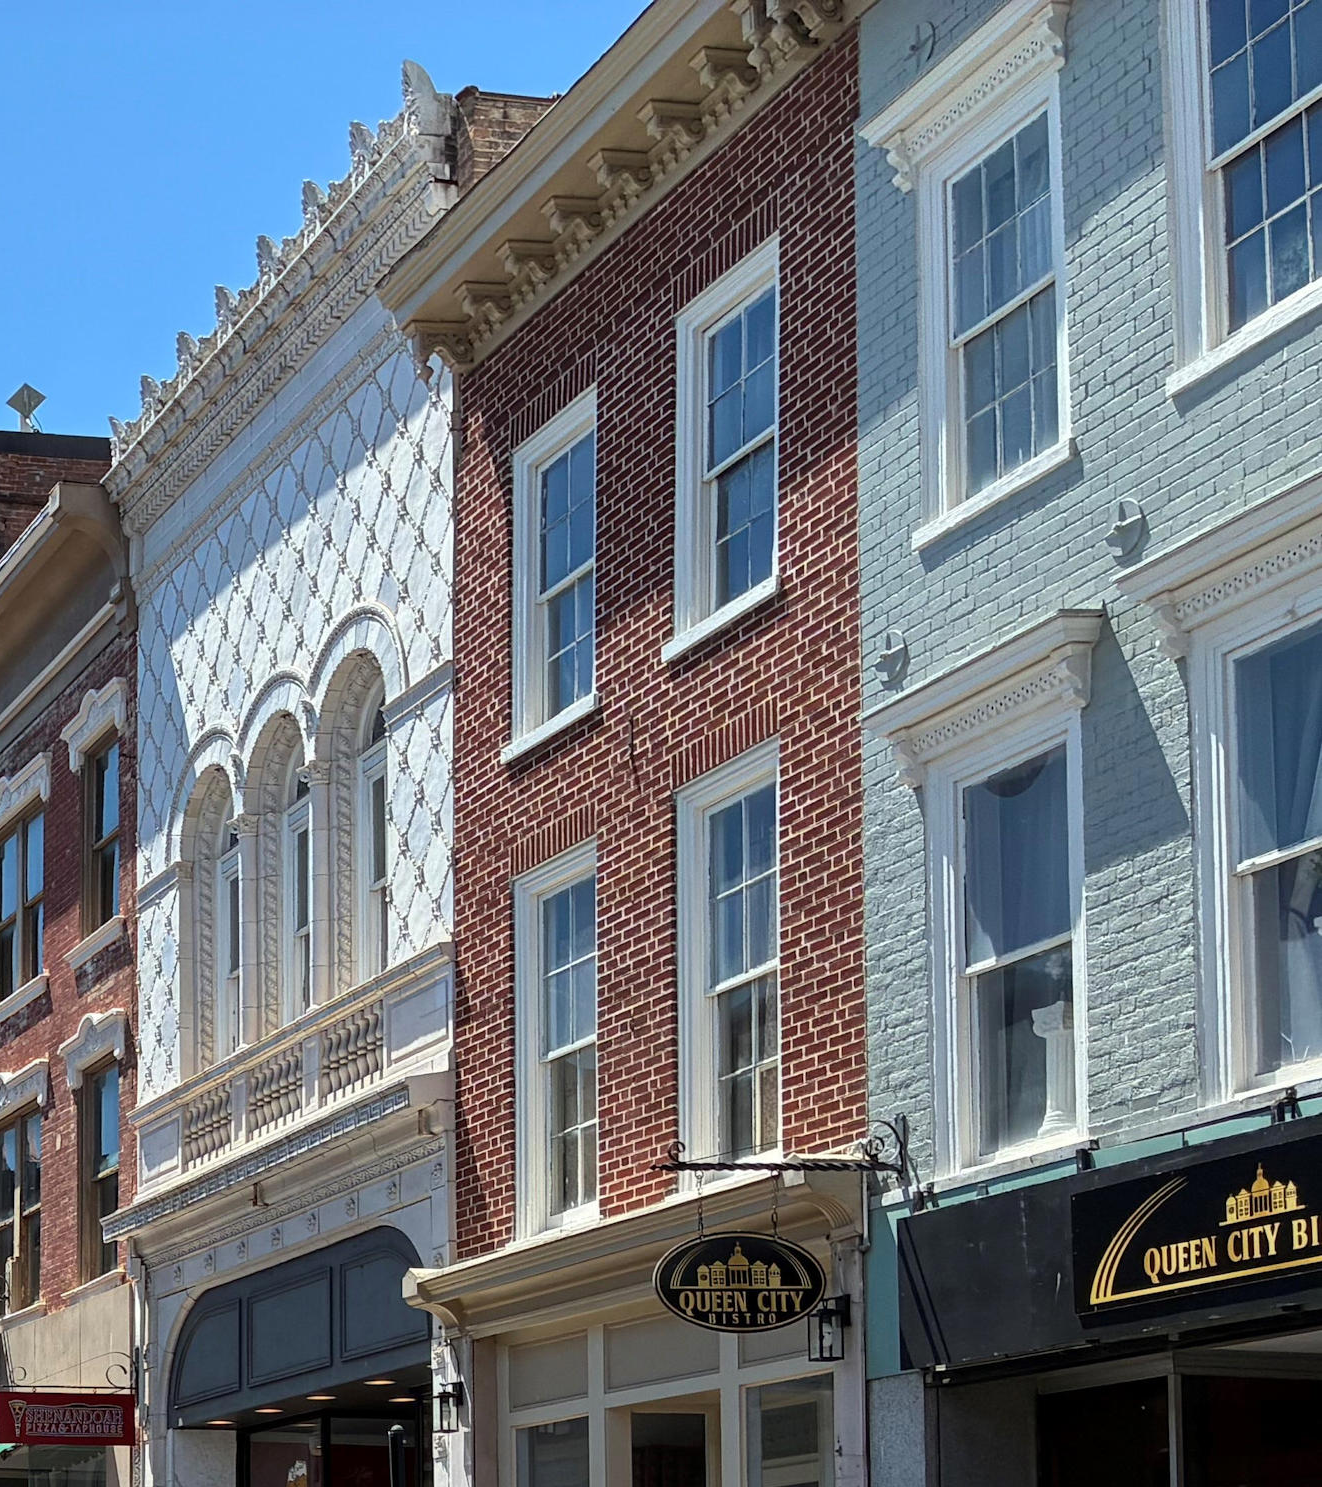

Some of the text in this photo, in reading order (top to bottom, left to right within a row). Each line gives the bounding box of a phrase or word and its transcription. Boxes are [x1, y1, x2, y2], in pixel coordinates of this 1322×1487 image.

[1143, 1237, 1218, 1284] QUEEN
[1227, 1222, 1281, 1262] CITY
[678, 1289, 806, 1316] QUEEN CITY
[708, 1312, 777, 1325] BISTRO
[26, 1408, 123, 1424] SHENANDOAH
[26, 1423, 57, 1433] PIZZA
[70, 1423, 123, 1433] TAPHOUSE
